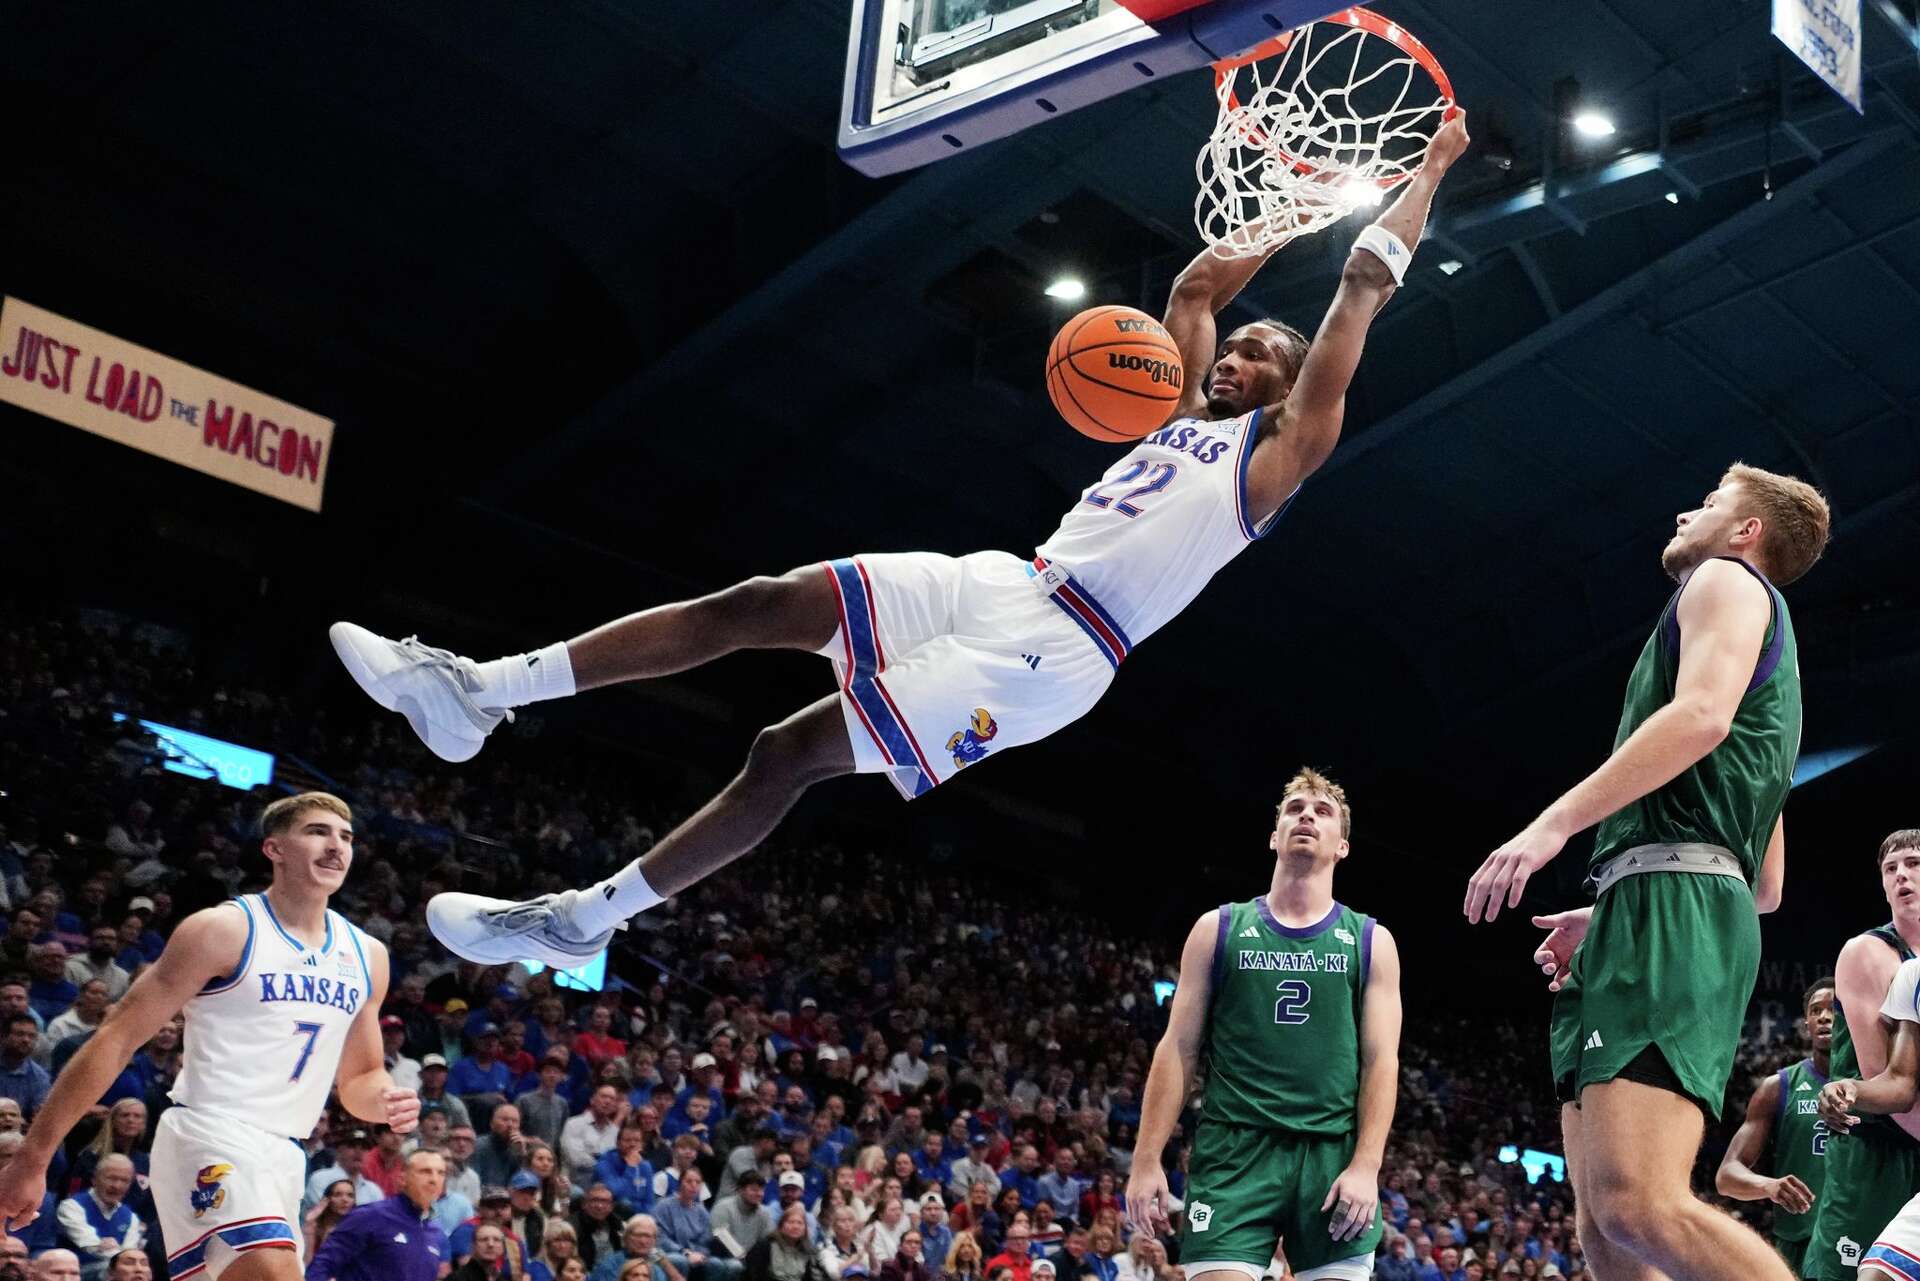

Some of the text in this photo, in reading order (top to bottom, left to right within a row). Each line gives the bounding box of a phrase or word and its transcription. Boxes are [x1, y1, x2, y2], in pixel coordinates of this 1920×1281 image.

[1109, 353, 1181, 389] Wilson
[2, 326, 321, 483] JUST LOAD THE WAGON
[1143, 425, 1230, 464] NSAS
[1084, 460, 1177, 518] 22
[259, 973, 360, 1015] KANSAS
[1275, 980, 1311, 1024] 2
[288, 1020, 325, 1084] 7
[1797, 1100, 1819, 1114] KA
[1812, 1120, 1830, 1156] 2
[1841, 1244, 1857, 1258] GB
